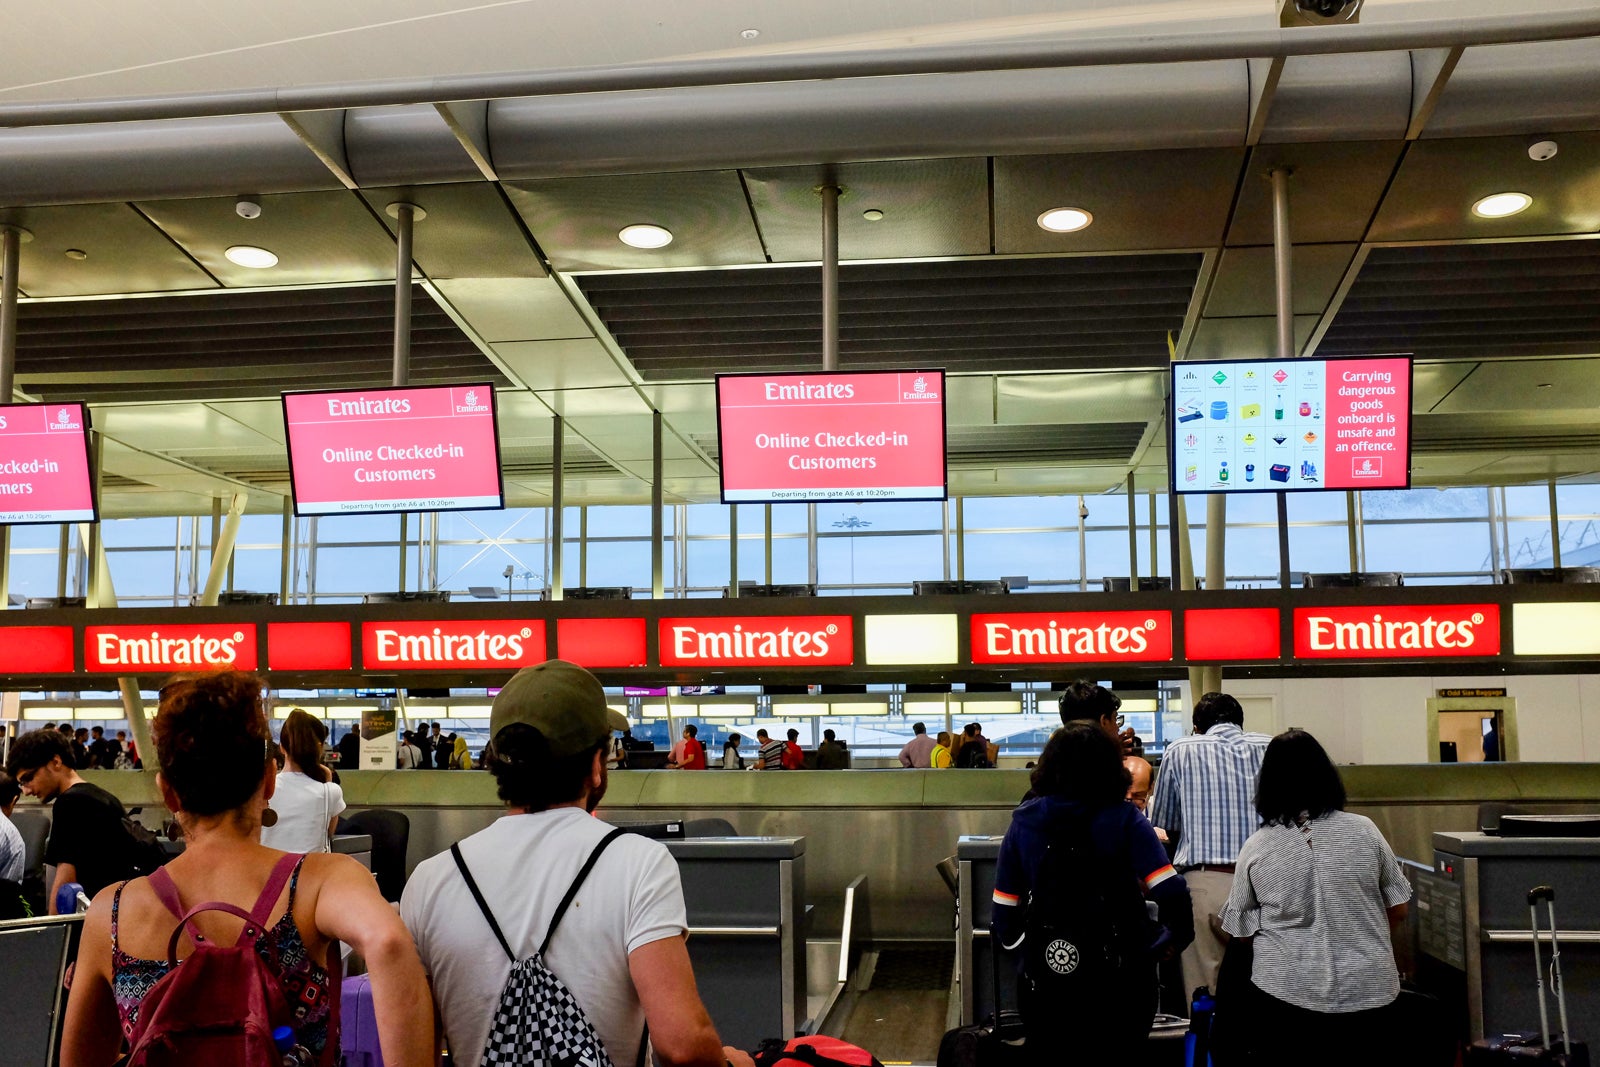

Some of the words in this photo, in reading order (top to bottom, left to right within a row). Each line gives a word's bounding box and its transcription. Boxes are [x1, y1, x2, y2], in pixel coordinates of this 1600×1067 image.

[1342, 371, 1392, 383] Carrying
[764, 381, 855, 400] Emirates
[903, 391, 938, 400] Emirates
[1338, 386, 1396, 398] dangerous
[328, 398, 411, 416] Emirates
[456, 404, 489, 413] Emirates
[1350, 399, 1384, 412] goods
[1337, 413, 1384, 424] onboard
[1386, 412, 1396, 422] is
[49, 422, 80, 430] Emirates
[1337, 427, 1373, 438] unsafe
[1375, 427, 1396, 437] and
[755, 433, 810, 448] Online
[814, 431, 909, 447] Checked-in
[1335, 443, 1349, 452] an
[1351, 441, 1396, 451] offence.
[322, 446, 373, 463] Online
[377, 443, 464, 460] Checked-in
[0, 459, 59, 474] ecked-in
[788, 455, 877, 470] Customers
[354, 467, 436, 483] Customers
[771, 490, 807, 498] Departing
[340, 503, 374, 511] Departing
